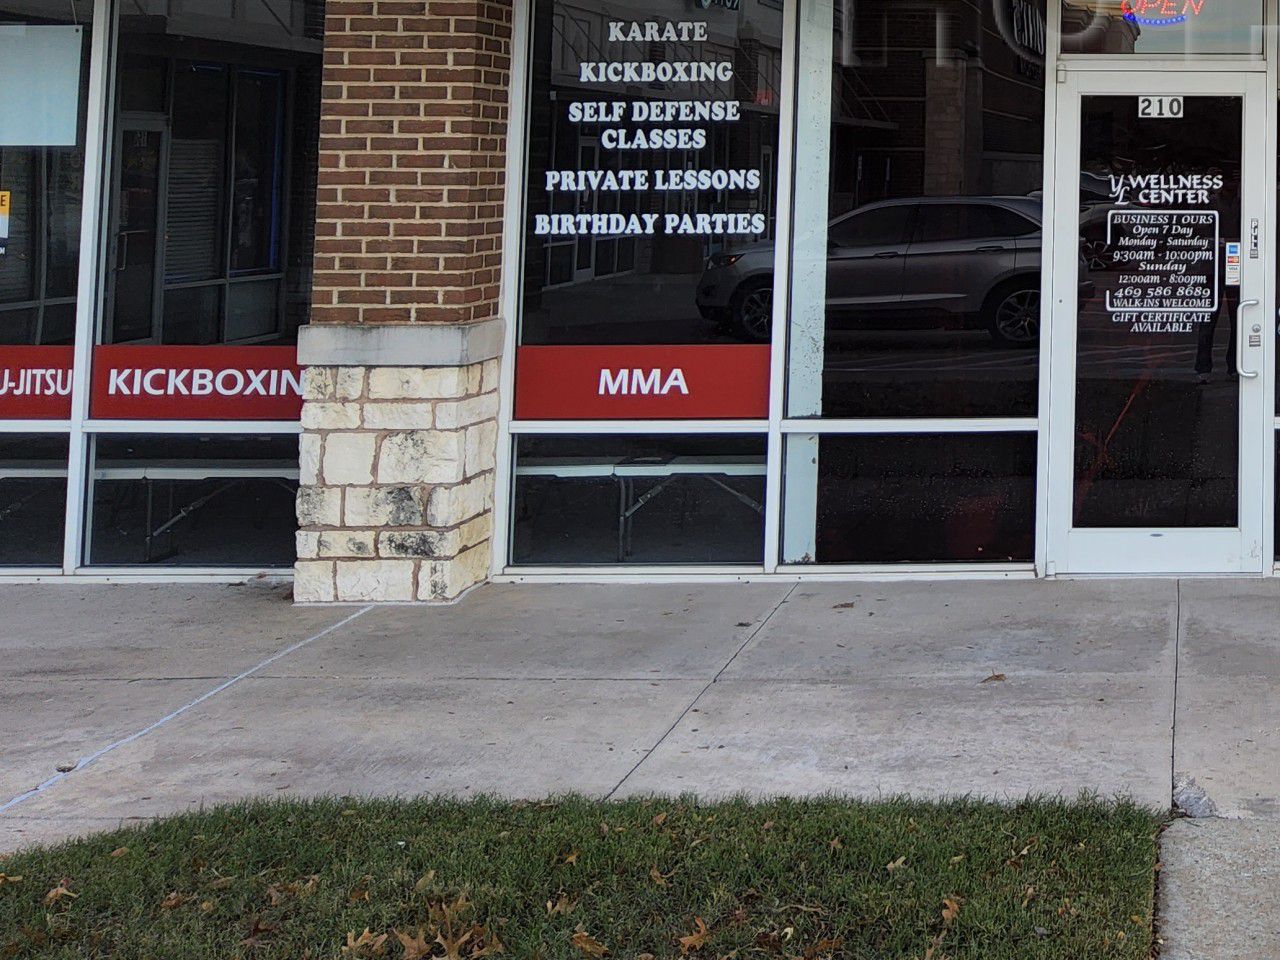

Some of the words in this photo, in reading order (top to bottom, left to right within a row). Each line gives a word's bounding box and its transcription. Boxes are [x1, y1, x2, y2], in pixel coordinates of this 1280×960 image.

[608, 21, 709, 42] KARATE
[579, 61, 734, 83] KICKBOXING
[568, 100, 626, 122] SELF
[631, 100, 741, 122] DEFENSE
[1141, 98, 1182, 116] 210
[601, 128, 706, 149] CLASSES
[545, 169, 649, 191] PRIVATE
[654, 169, 761, 191] LESSONS
[1128, 174, 1223, 189] WELLNESS
[1138, 189, 1210, 204] CENTER
[534, 213, 659, 235] BIRTHDAY
[664, 213, 766, 235] PARTIES
[1113, 215, 1169, 224] BUSINESS
[1132, 225, 1159, 237] Open
[1162, 226, 1169, 234] 7
[1171, 225, 1194, 237] Day
[1118, 235, 1157, 249] Monday
[1166, 236, 1209, 249] Saturday
[1112, 250, 1155, 262] 9:30am
[1164, 250, 1214, 264] 10:00pm
[1138, 260, 1187, 274] Sunday
[1118, 275, 1160, 283] 12:00am
[1168, 273, 1207, 286] 8:00pm
[1114, 286, 1142, 298] 469
[1146, 286, 1172, 298] 586
[1176, 286, 1211, 298] 8689
[1113, 299, 1160, 308] WALK-INS
[1162, 299, 1212, 308] WELCOME
[1112, 312, 1139, 323] GIFT
[1141, 312, 1212, 323] CERTIFICATE
[1130, 322, 1193, 333] AVAILABLE
[598, 368, 689, 395] MMA
